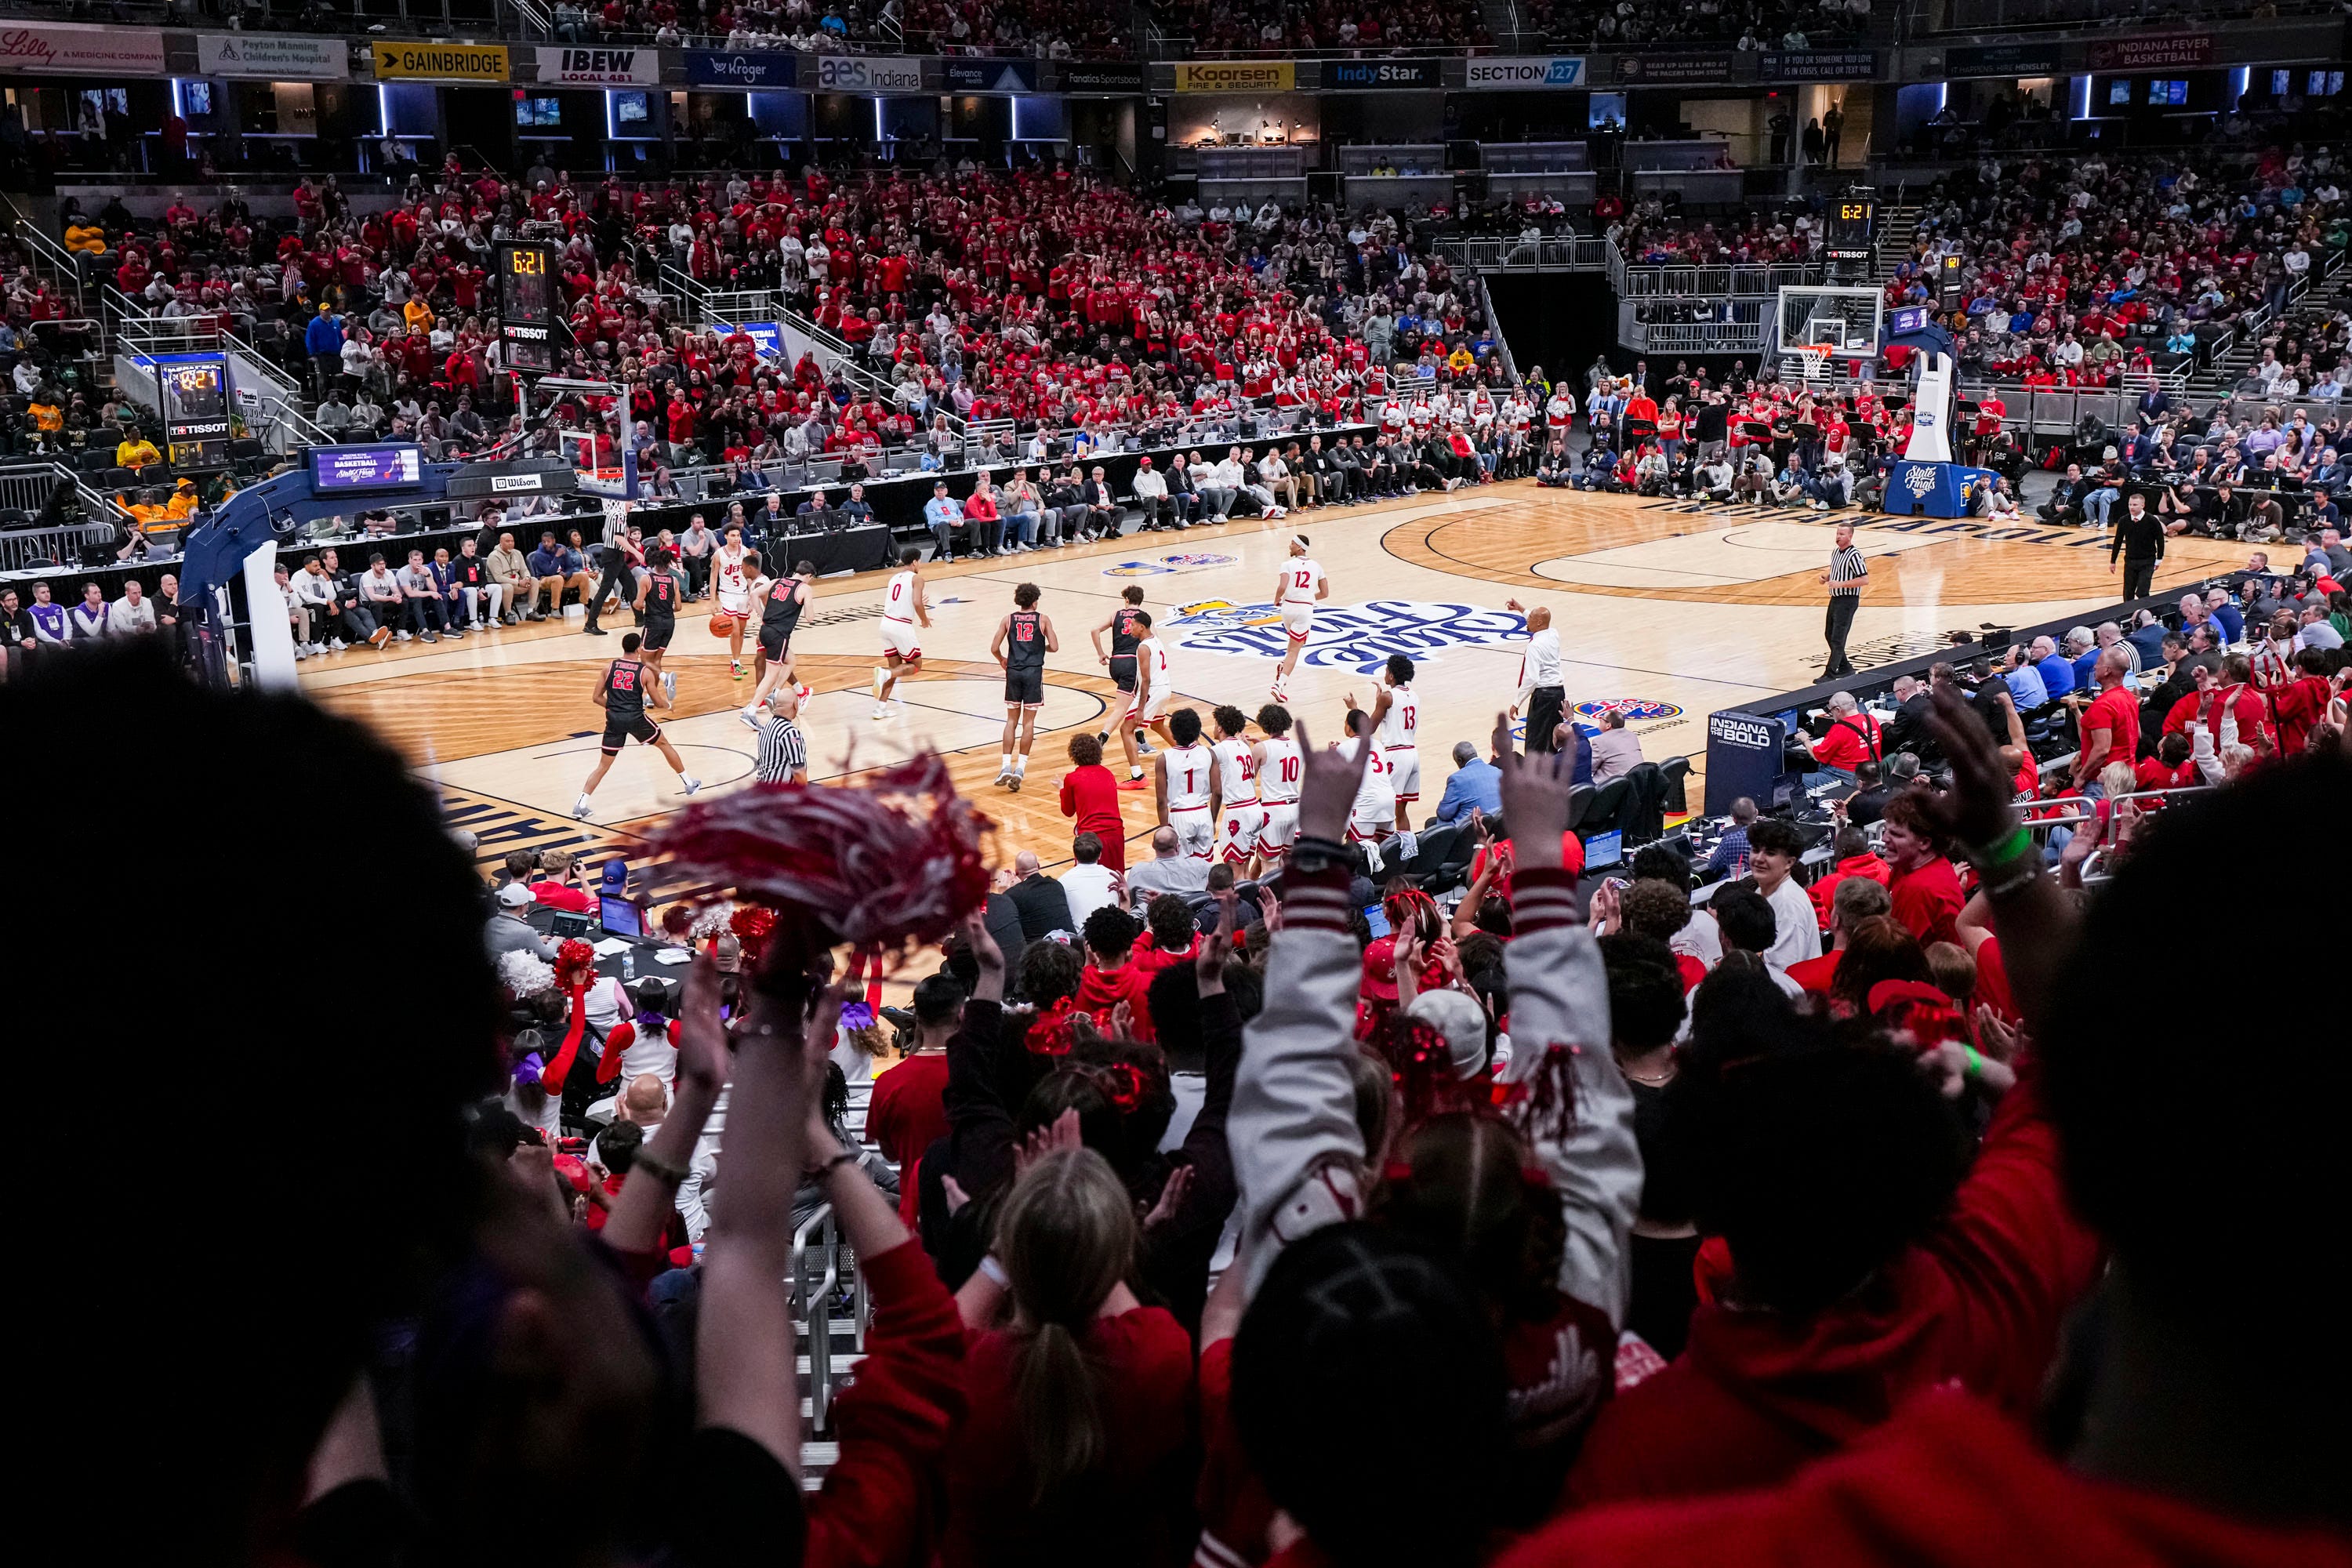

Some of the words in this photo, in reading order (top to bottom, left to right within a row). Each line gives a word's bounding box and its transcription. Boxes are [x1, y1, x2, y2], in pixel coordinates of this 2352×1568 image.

[0, 30, 57, 65] Lilly
[242, 40, 274, 49] Peyton
[278, 42, 319, 53] Manning
[2117, 40, 2170, 53] INDIANA
[2171, 38, 2209, 50] FEVER
[71, 51, 117, 60] MEDICINE
[118, 53, 163, 61] COMPANY
[243, 52, 290, 63] Children's
[292, 54, 331, 65] Hospital
[403, 52, 503, 73] GAINBRIDGE
[561, 50, 635, 72] IBEW
[1792, 56, 1804, 64] YOU
[1815, 55, 1843, 64] SOMEONE
[2123, 51, 2201, 64] BASKETBALL
[561, 73, 607, 82] LOCAL
[728, 58, 767, 83] Kroger
[822, 60, 867, 85] aes
[871, 69, 919, 86] Indiana
[949, 67, 982, 78] Elevance
[1188, 66, 1279, 81] Koorsen
[1470, 66, 1544, 80] SECTION
[1549, 65, 1574, 79] 127
[1820, 66, 1834, 74] CALL
[1835, 66, 1844, 74] OR
[1069, 73, 1100, 84] Fanatics
[1101, 74, 1142, 85] Sportsbook
[1842, 205, 1871, 219] 6:21
[513, 251, 546, 274] 6:21
[517, 327, 549, 340] TISSOT
[187, 423, 228, 434] TISSOT
[334, 459, 378, 468] BASKETBALL
[1906, 465, 1937, 477] State
[508, 478, 536, 488] Wilson
[1904, 475, 1936, 492] Finals
[1638, 499, 2168, 550] INDIANAPOLI
[732, 575, 739, 586] 5
[1295, 571, 1310, 589] 12
[659, 584, 667, 600] 5
[771, 583, 791, 601] 30
[891, 583, 902, 601] 0
[1016, 622, 1034, 641] 12
[613, 670, 634, 690] 22
[1403, 706, 1415, 730] 13
[1711, 717, 1769, 736] INDIANA
[1724, 728, 1770, 747] BOLD
[1279, 756, 1300, 782] 10
[1184, 768, 1193, 793] 1
